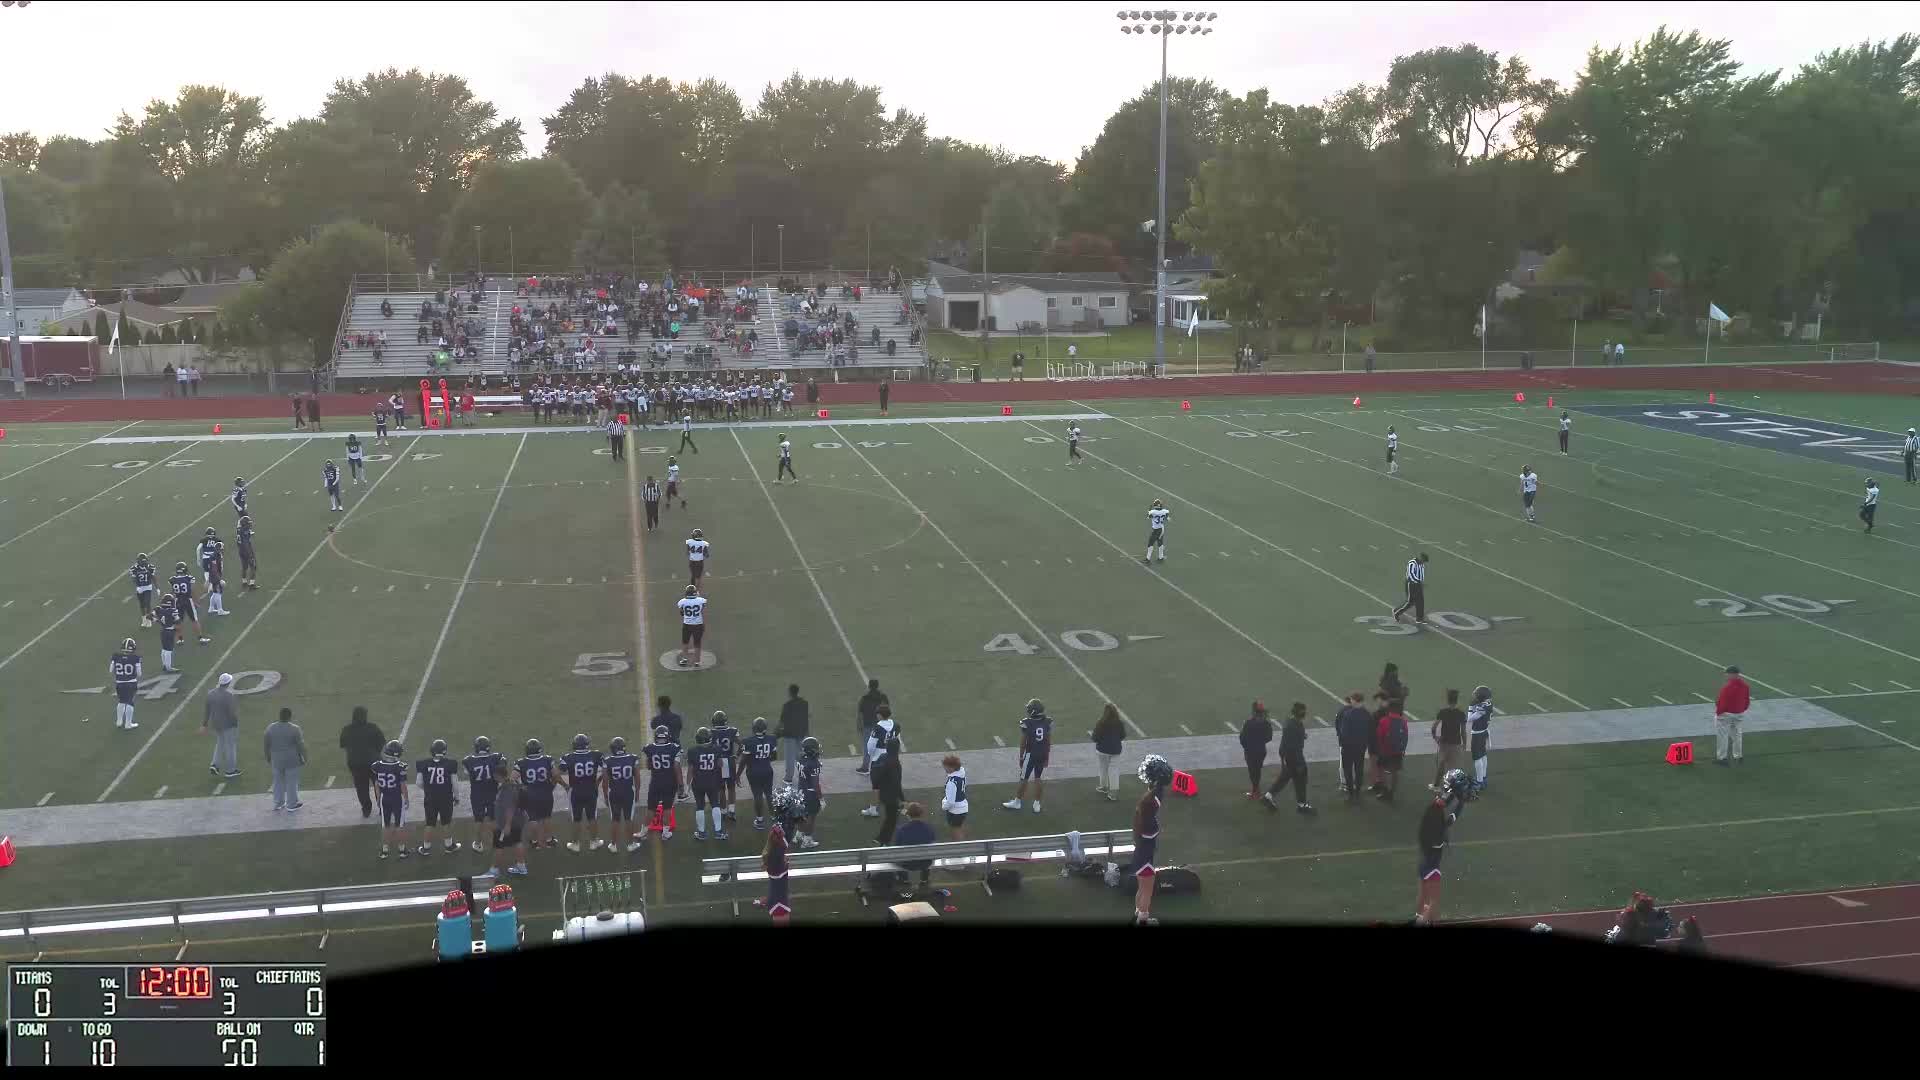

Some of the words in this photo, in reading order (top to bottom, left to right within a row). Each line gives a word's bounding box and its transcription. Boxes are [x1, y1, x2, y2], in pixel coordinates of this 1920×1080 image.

[138, 573, 149, 583] 21
[684, 604, 700, 618] 62
[1694, 594, 1831, 617] 20
[1353, 611, 1489, 635] 30
[983, 629, 1119, 655] 40
[115, 662, 134, 676] 20
[572, 649, 717, 676] 50
[112, 669, 282, 699] 40
[1034, 727, 1044, 742] 9
[755, 743, 771, 759] 59
[1675, 745, 1689, 761] 30
[574, 761, 595, 777] 66
[652, 754, 671, 770] 65
[699, 753, 715, 770] 53
[377, 772, 397, 789] 52
[427, 766, 446, 785] 78
[473, 764, 492, 782] 71
[526, 766, 548, 784] 93
[611, 765, 633, 780] 50
[1176, 774, 1189, 791] 40
